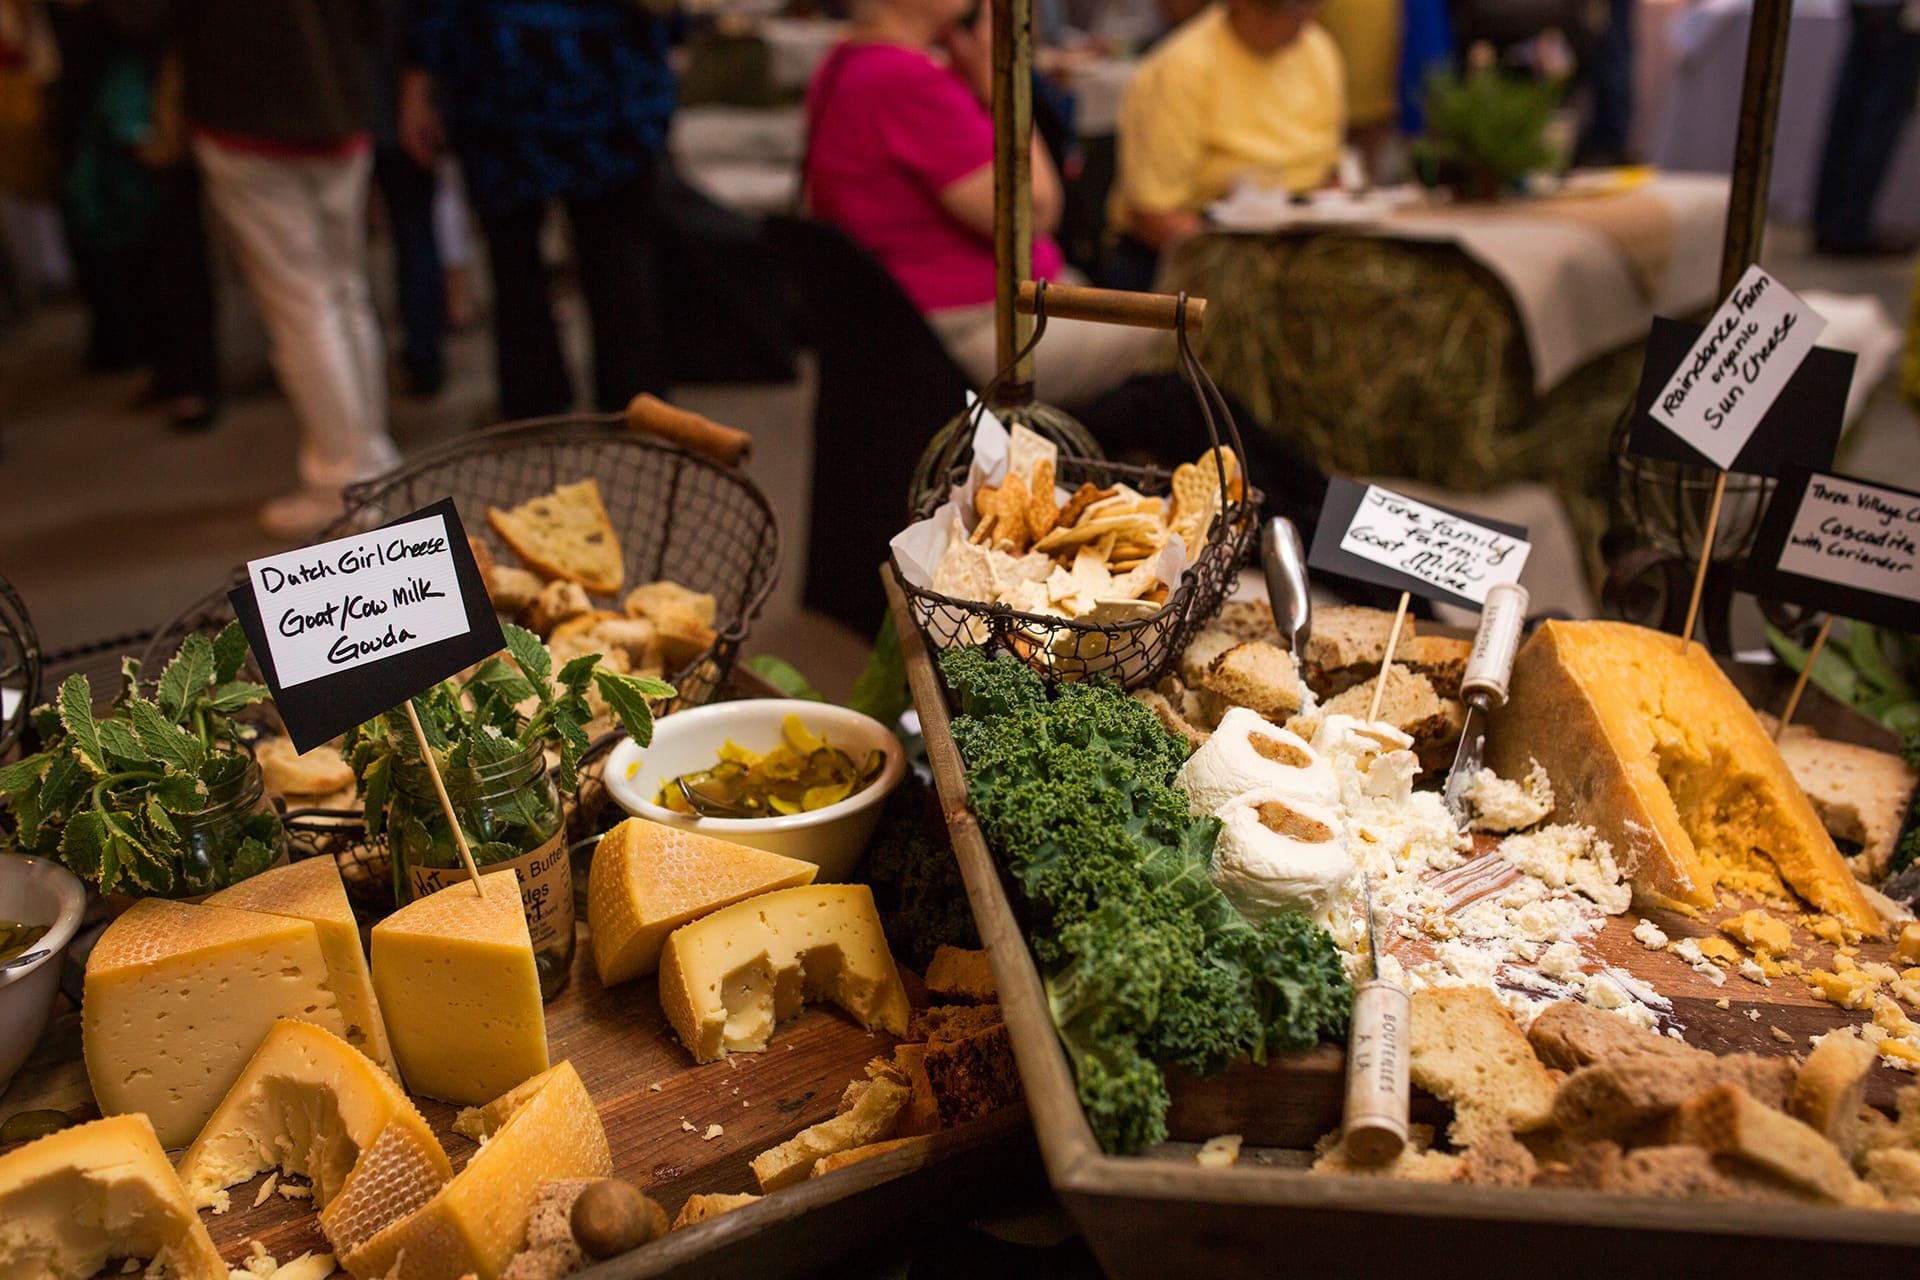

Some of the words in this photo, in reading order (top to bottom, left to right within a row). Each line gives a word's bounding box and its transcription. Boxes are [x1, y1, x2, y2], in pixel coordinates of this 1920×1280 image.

[1662, 316, 1740, 417] Raindance
[1732, 275, 1770, 315] Farm
[1711, 322, 1759, 385] organic
[1704, 385, 1745, 430] Sun
[1743, 312, 1797, 383] Cheese
[1858, 493, 1902, 526] Village
[260, 559, 337, 594] Dutch
[337, 546, 385, 574] Girl
[385, 536, 448, 562] Cheese
[1350, 526, 1405, 552] Goat
[1409, 551, 1485, 581] Milk
[1432, 518, 1516, 566] Family
[1791, 533, 1823, 554] with
[1827, 541, 1913, 573] Coriander
[393, 577, 446, 608] Milk
[327, 624, 417, 665] Gouda
[529, 847, 563, 879] Butte
